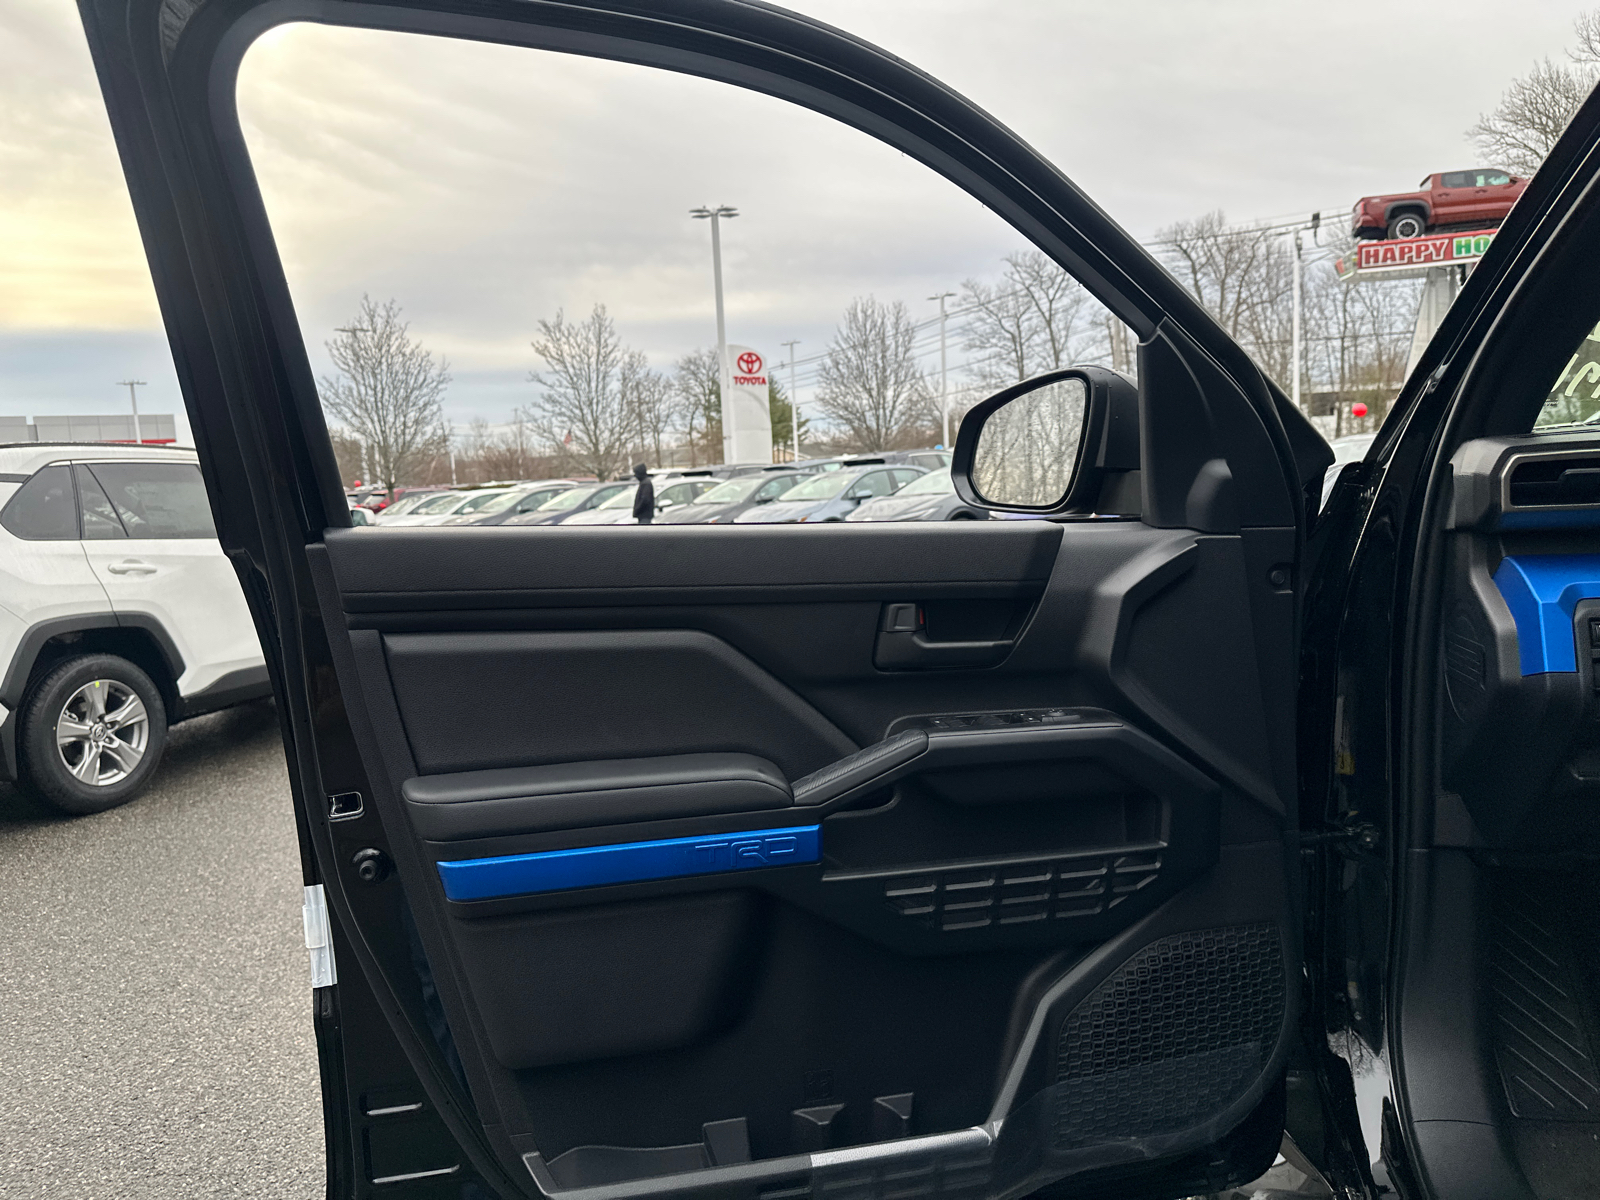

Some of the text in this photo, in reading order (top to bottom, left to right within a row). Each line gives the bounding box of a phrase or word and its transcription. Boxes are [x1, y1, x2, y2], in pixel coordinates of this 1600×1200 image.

[1362, 239, 1448, 267] HAPPY
[733, 376, 767, 385] TOYOTA
[695, 836, 797, 867] TRD
